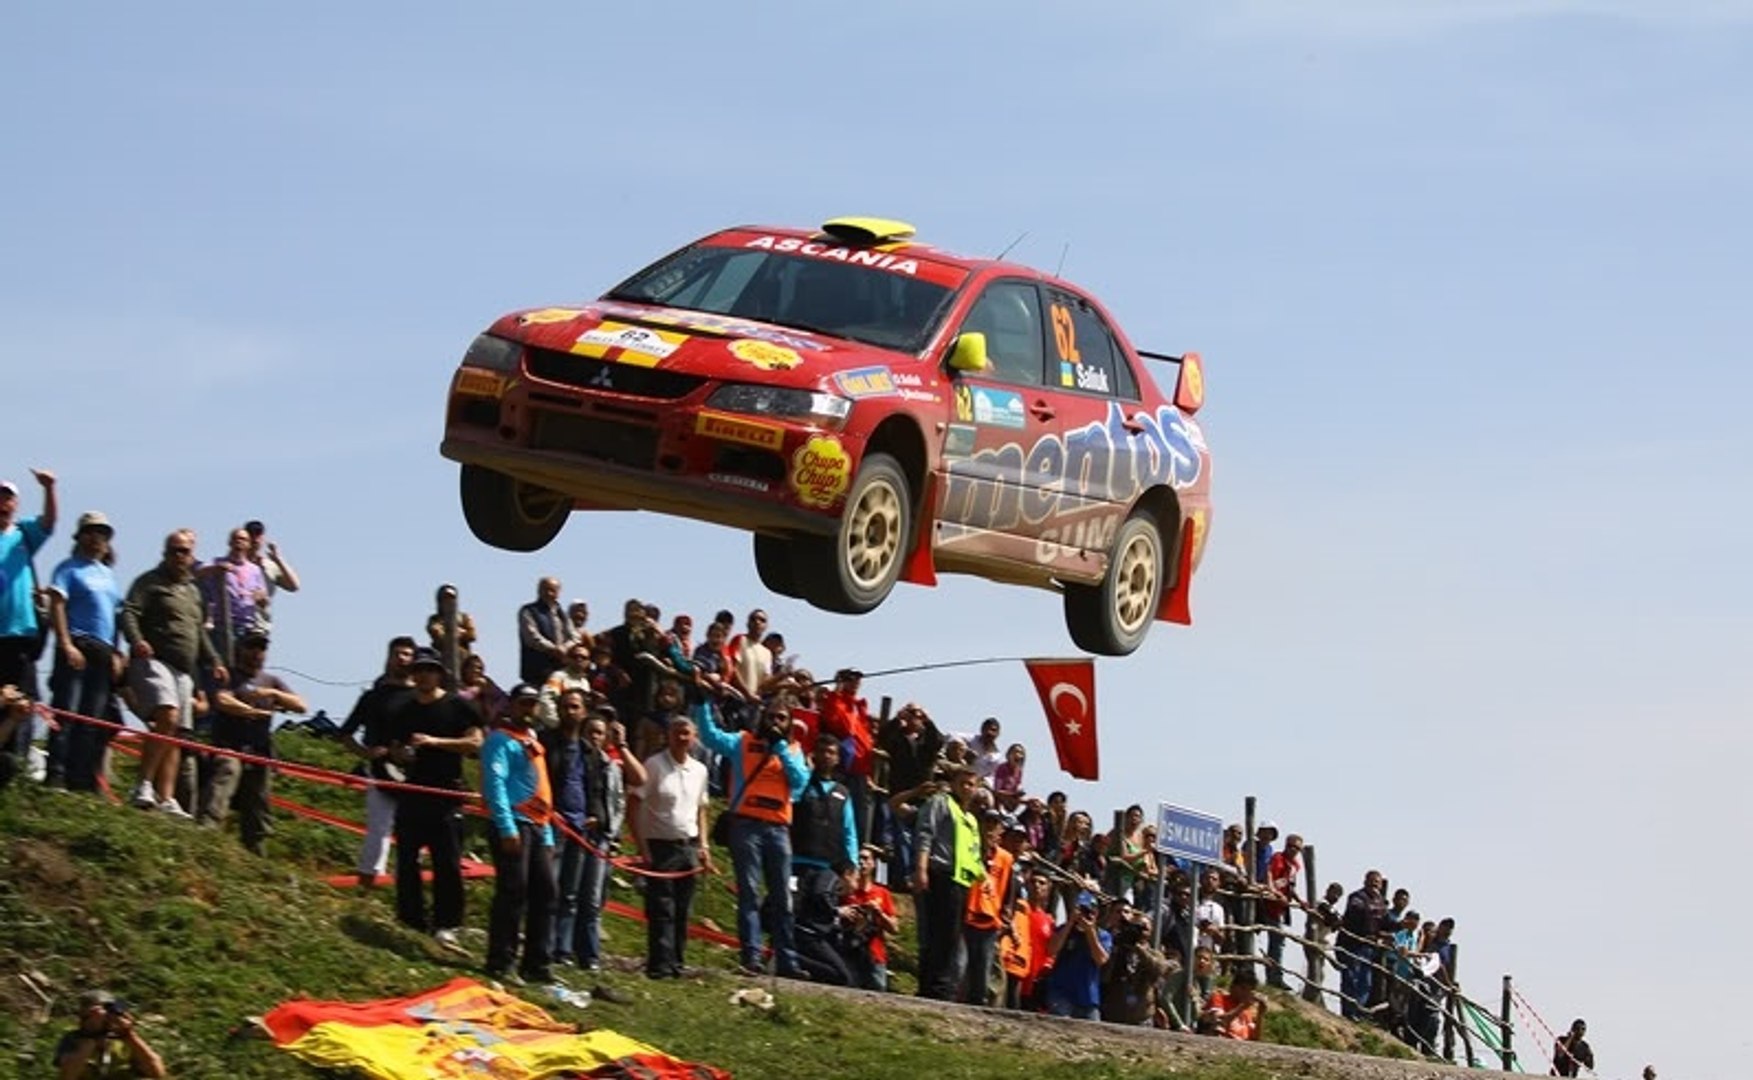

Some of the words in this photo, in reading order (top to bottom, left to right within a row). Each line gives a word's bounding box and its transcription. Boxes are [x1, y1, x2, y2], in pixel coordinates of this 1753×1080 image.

[745, 235, 919, 275] ASCANIA
[1051, 303, 1081, 364] 62
[956, 384, 973, 421] 62
[704, 420, 776, 444] PIRELLI
[796, 468, 842, 487] Chups
[801, 450, 845, 472] Chupa
[938, 401, 1201, 545] mentos
